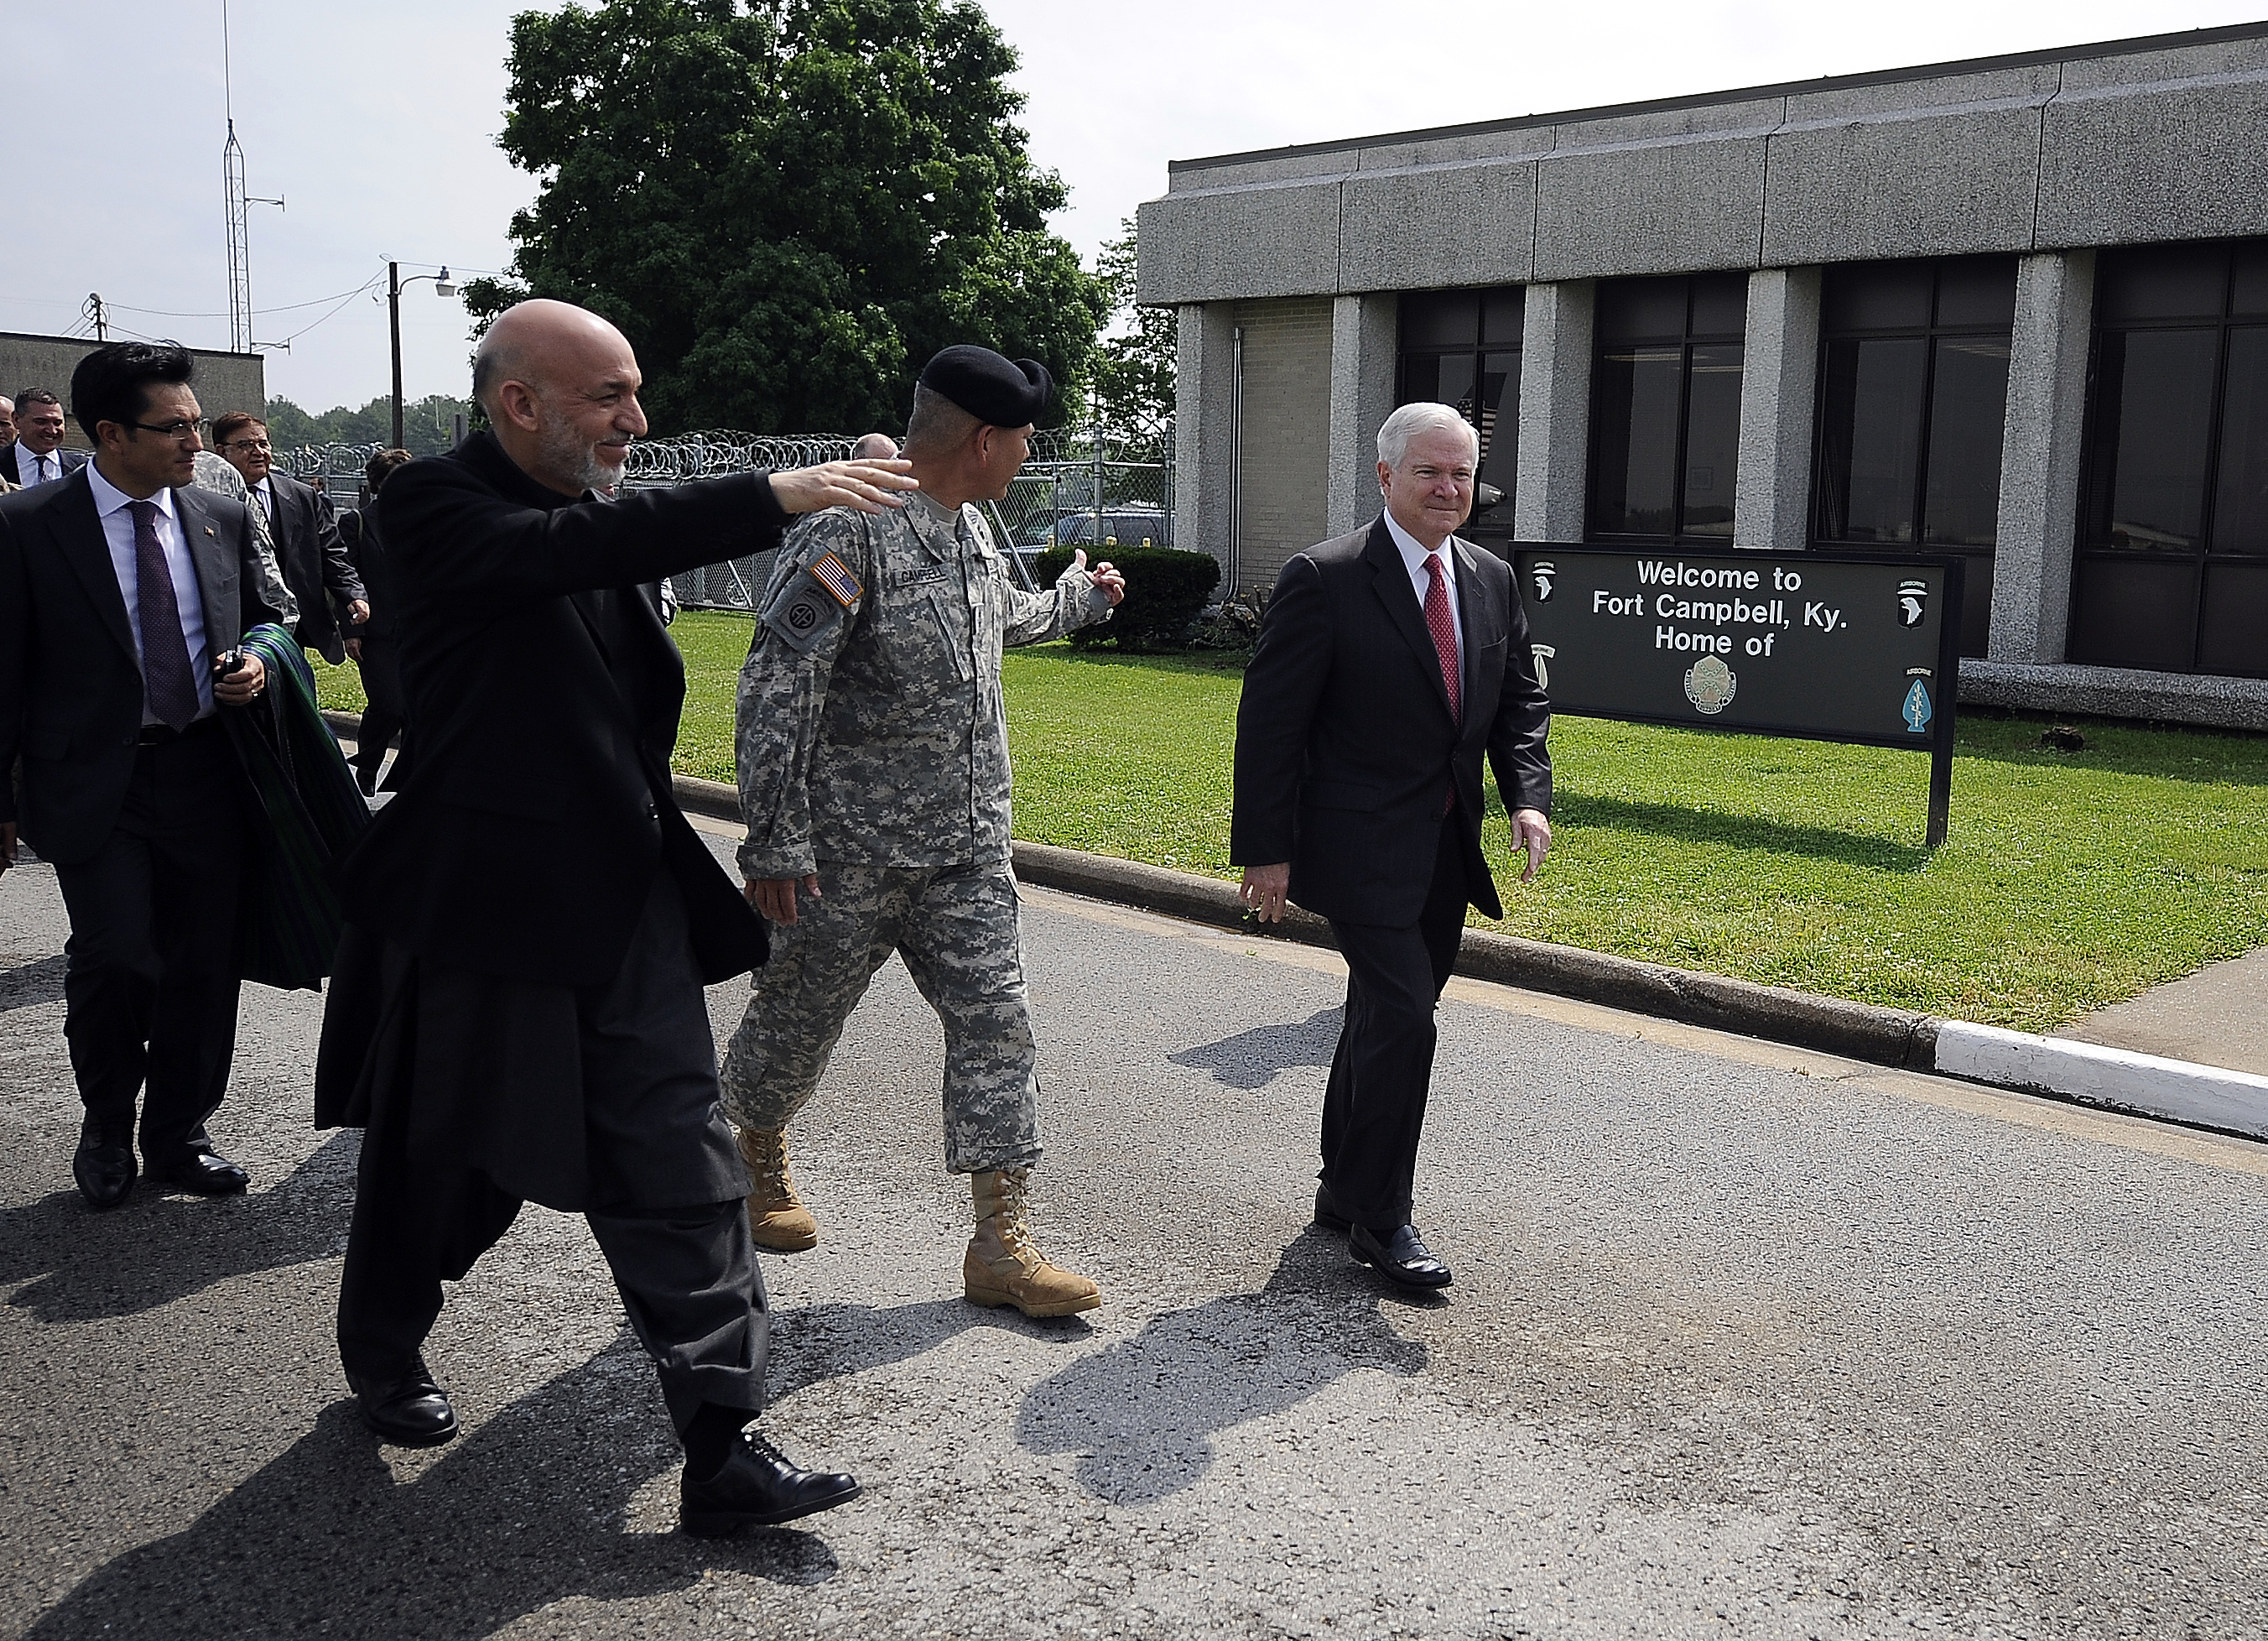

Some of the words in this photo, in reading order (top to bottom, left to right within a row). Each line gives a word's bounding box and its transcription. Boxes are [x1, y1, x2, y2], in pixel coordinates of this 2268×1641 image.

[1637, 560, 1760, 589] Welcome
[1772, 566, 1802, 591] to
[1593, 590, 1644, 616] Fort
[1656, 593, 1790, 630] Campbell,
[1803, 602, 1847, 632] Ky.
[1655, 625, 1732, 654] Home
[1745, 633, 1775, 657] of
